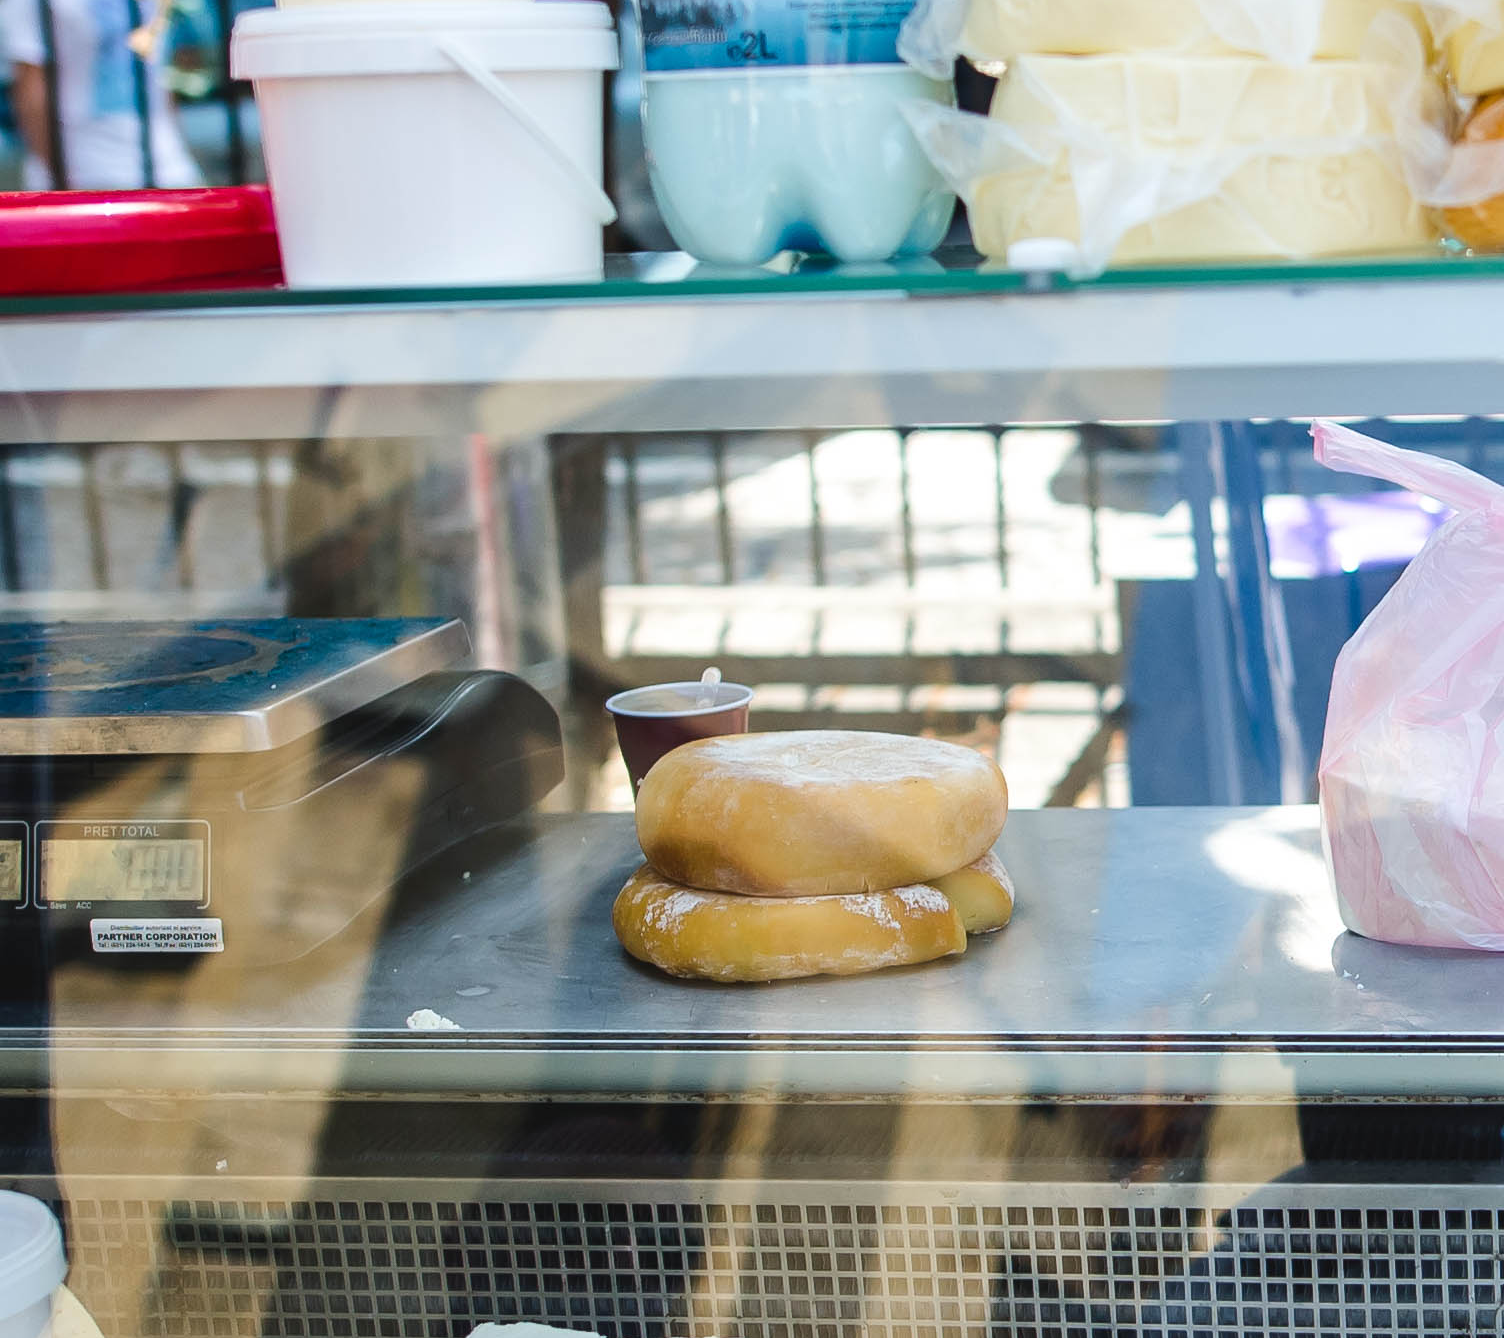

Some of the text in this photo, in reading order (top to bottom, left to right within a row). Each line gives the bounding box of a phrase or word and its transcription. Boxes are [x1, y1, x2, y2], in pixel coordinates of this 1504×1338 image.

[84, 826, 160, 838] PRET TOTAL
[97, 932, 217, 941] PARTNER CORPORATION
